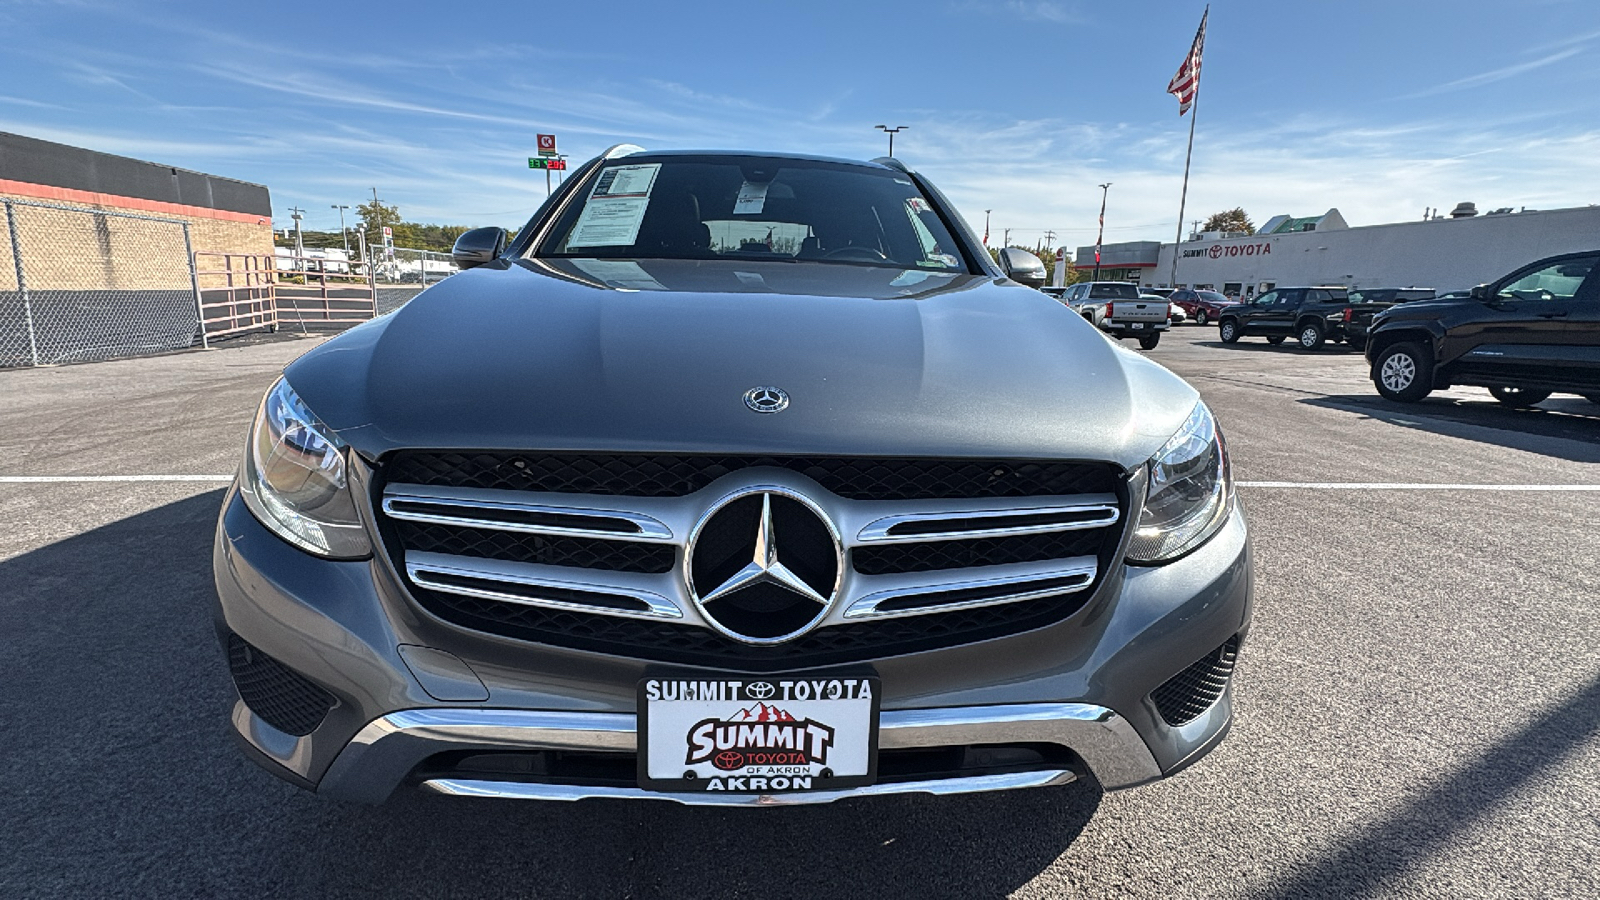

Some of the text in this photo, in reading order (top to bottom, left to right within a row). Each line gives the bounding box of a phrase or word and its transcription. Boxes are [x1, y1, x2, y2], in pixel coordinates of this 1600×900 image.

[1183, 243, 1271, 258] SUMMIT TOYOTA
[646, 679, 872, 701] SUMMIT TOYOTA
[691, 721, 830, 760] SUMMIT
[747, 753, 806, 764] TOYOTA
[766, 766, 811, 774] AKRON
[706, 777, 812, 791] AKRON
